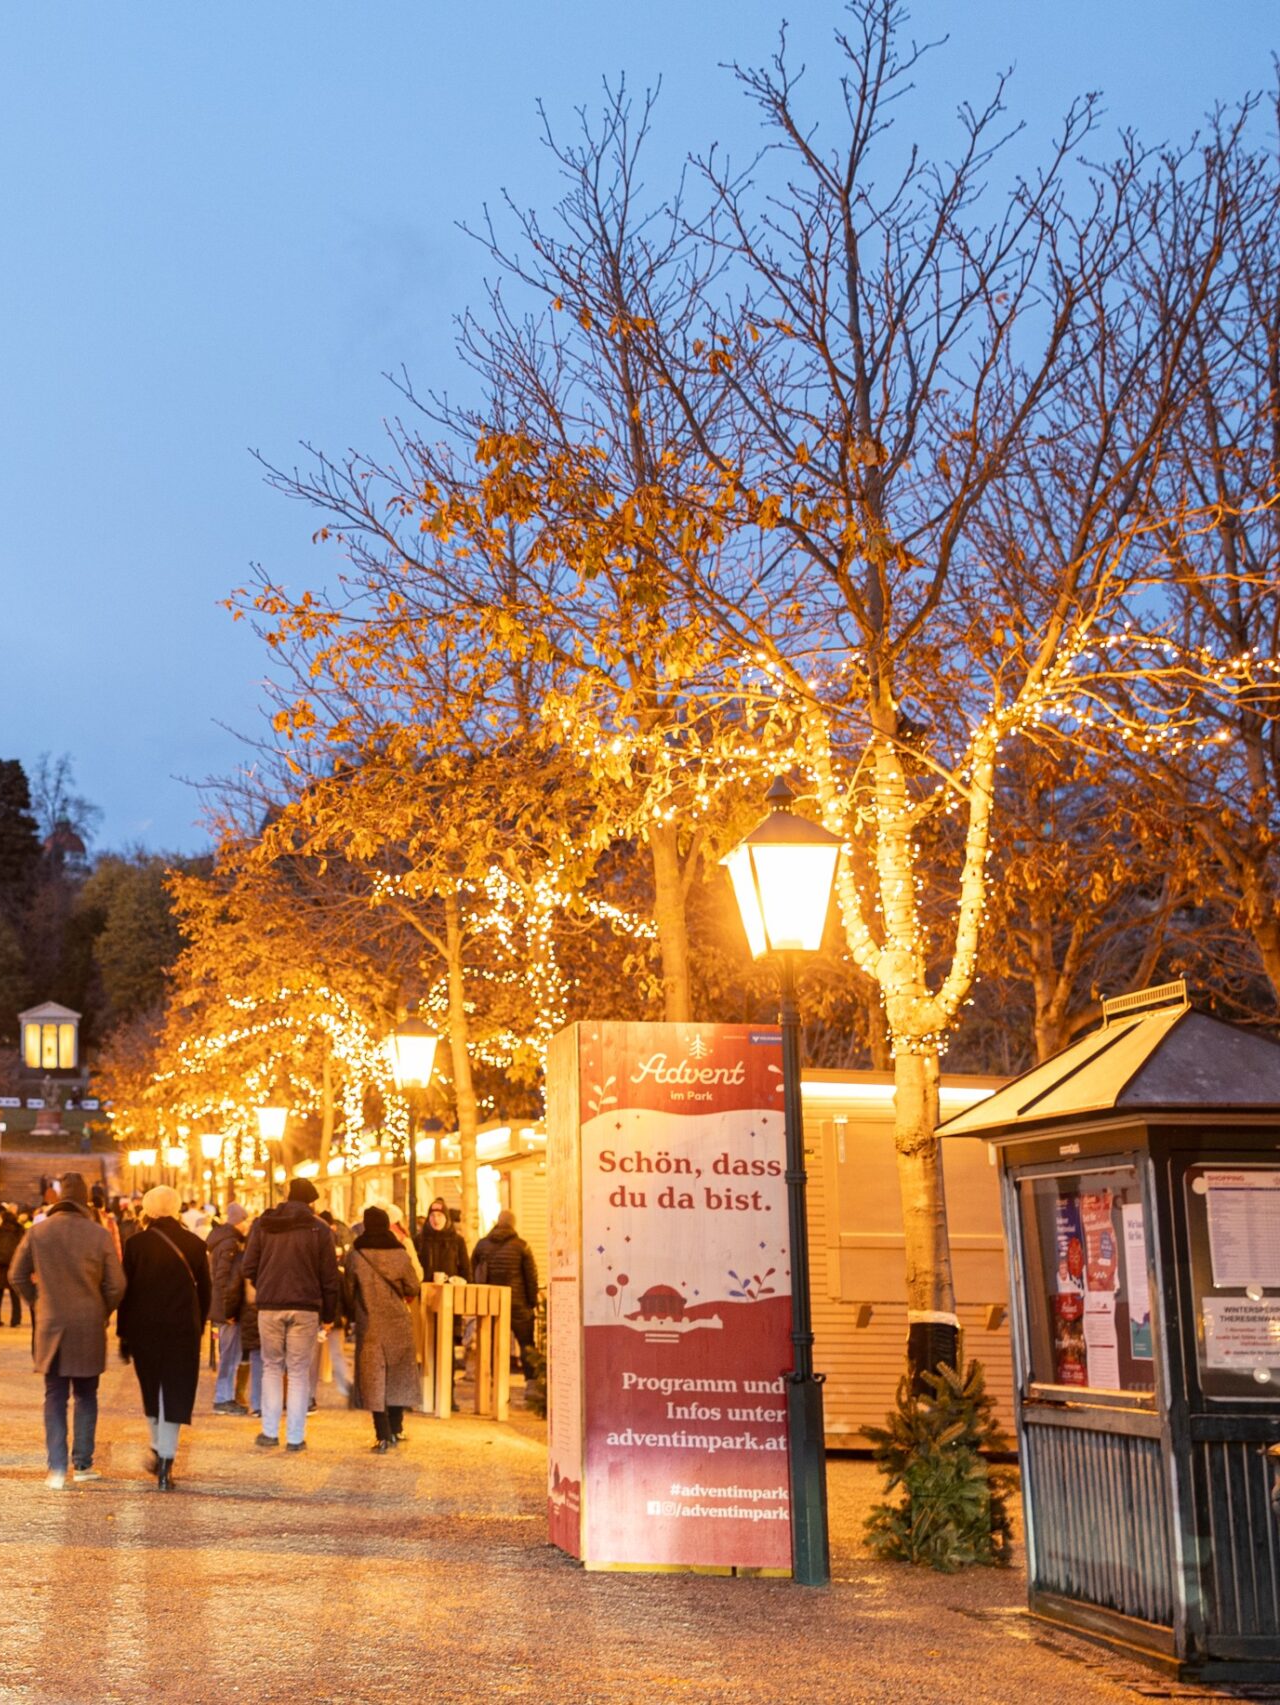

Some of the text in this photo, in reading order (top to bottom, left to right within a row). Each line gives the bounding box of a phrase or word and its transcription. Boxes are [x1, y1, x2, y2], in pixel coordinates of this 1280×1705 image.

[630, 1053, 745, 1085] Advent
[670, 1090, 713, 1101] im Park
[599, 1150, 782, 1179] Schön, dass
[609, 1185, 771, 1211] du da bist.
[622, 1372, 786, 1395] Programm und
[666, 1402, 787, 1423] Infos unter
[606, 1429, 787, 1453] adventimpark.at
[670, 1483, 789, 1502] #adventimpark
[675, 1502, 789, 1521] /adventimpark
